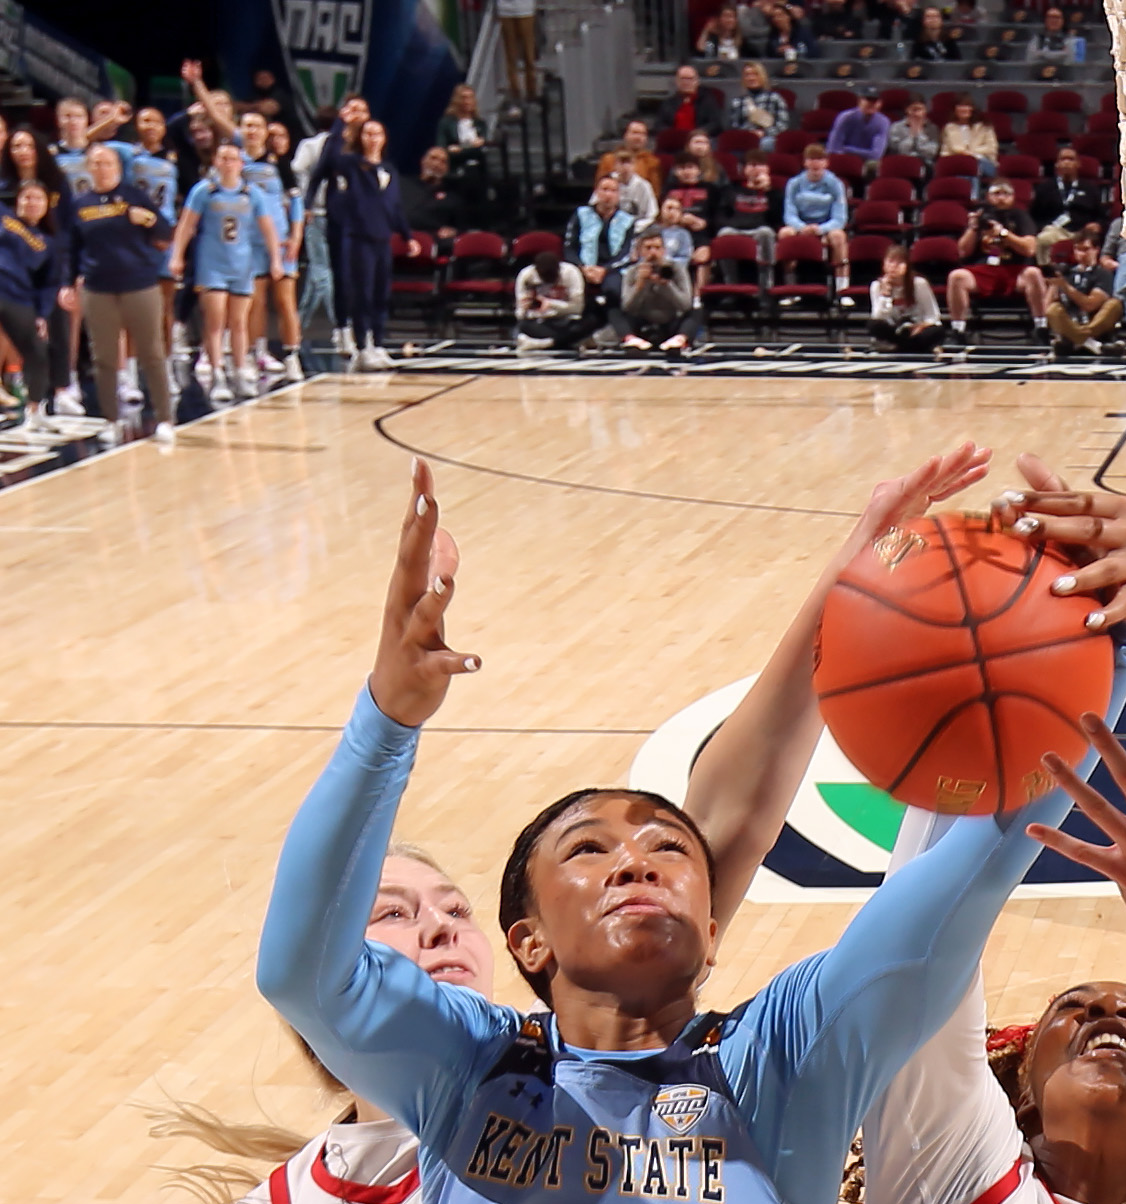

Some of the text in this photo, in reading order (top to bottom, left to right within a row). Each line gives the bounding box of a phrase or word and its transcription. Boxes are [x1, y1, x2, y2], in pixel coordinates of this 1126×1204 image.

[221, 216, 240, 243] 2
[654, 1099, 706, 1115] MAC
[464, 1110, 727, 1204] KENT STATE
